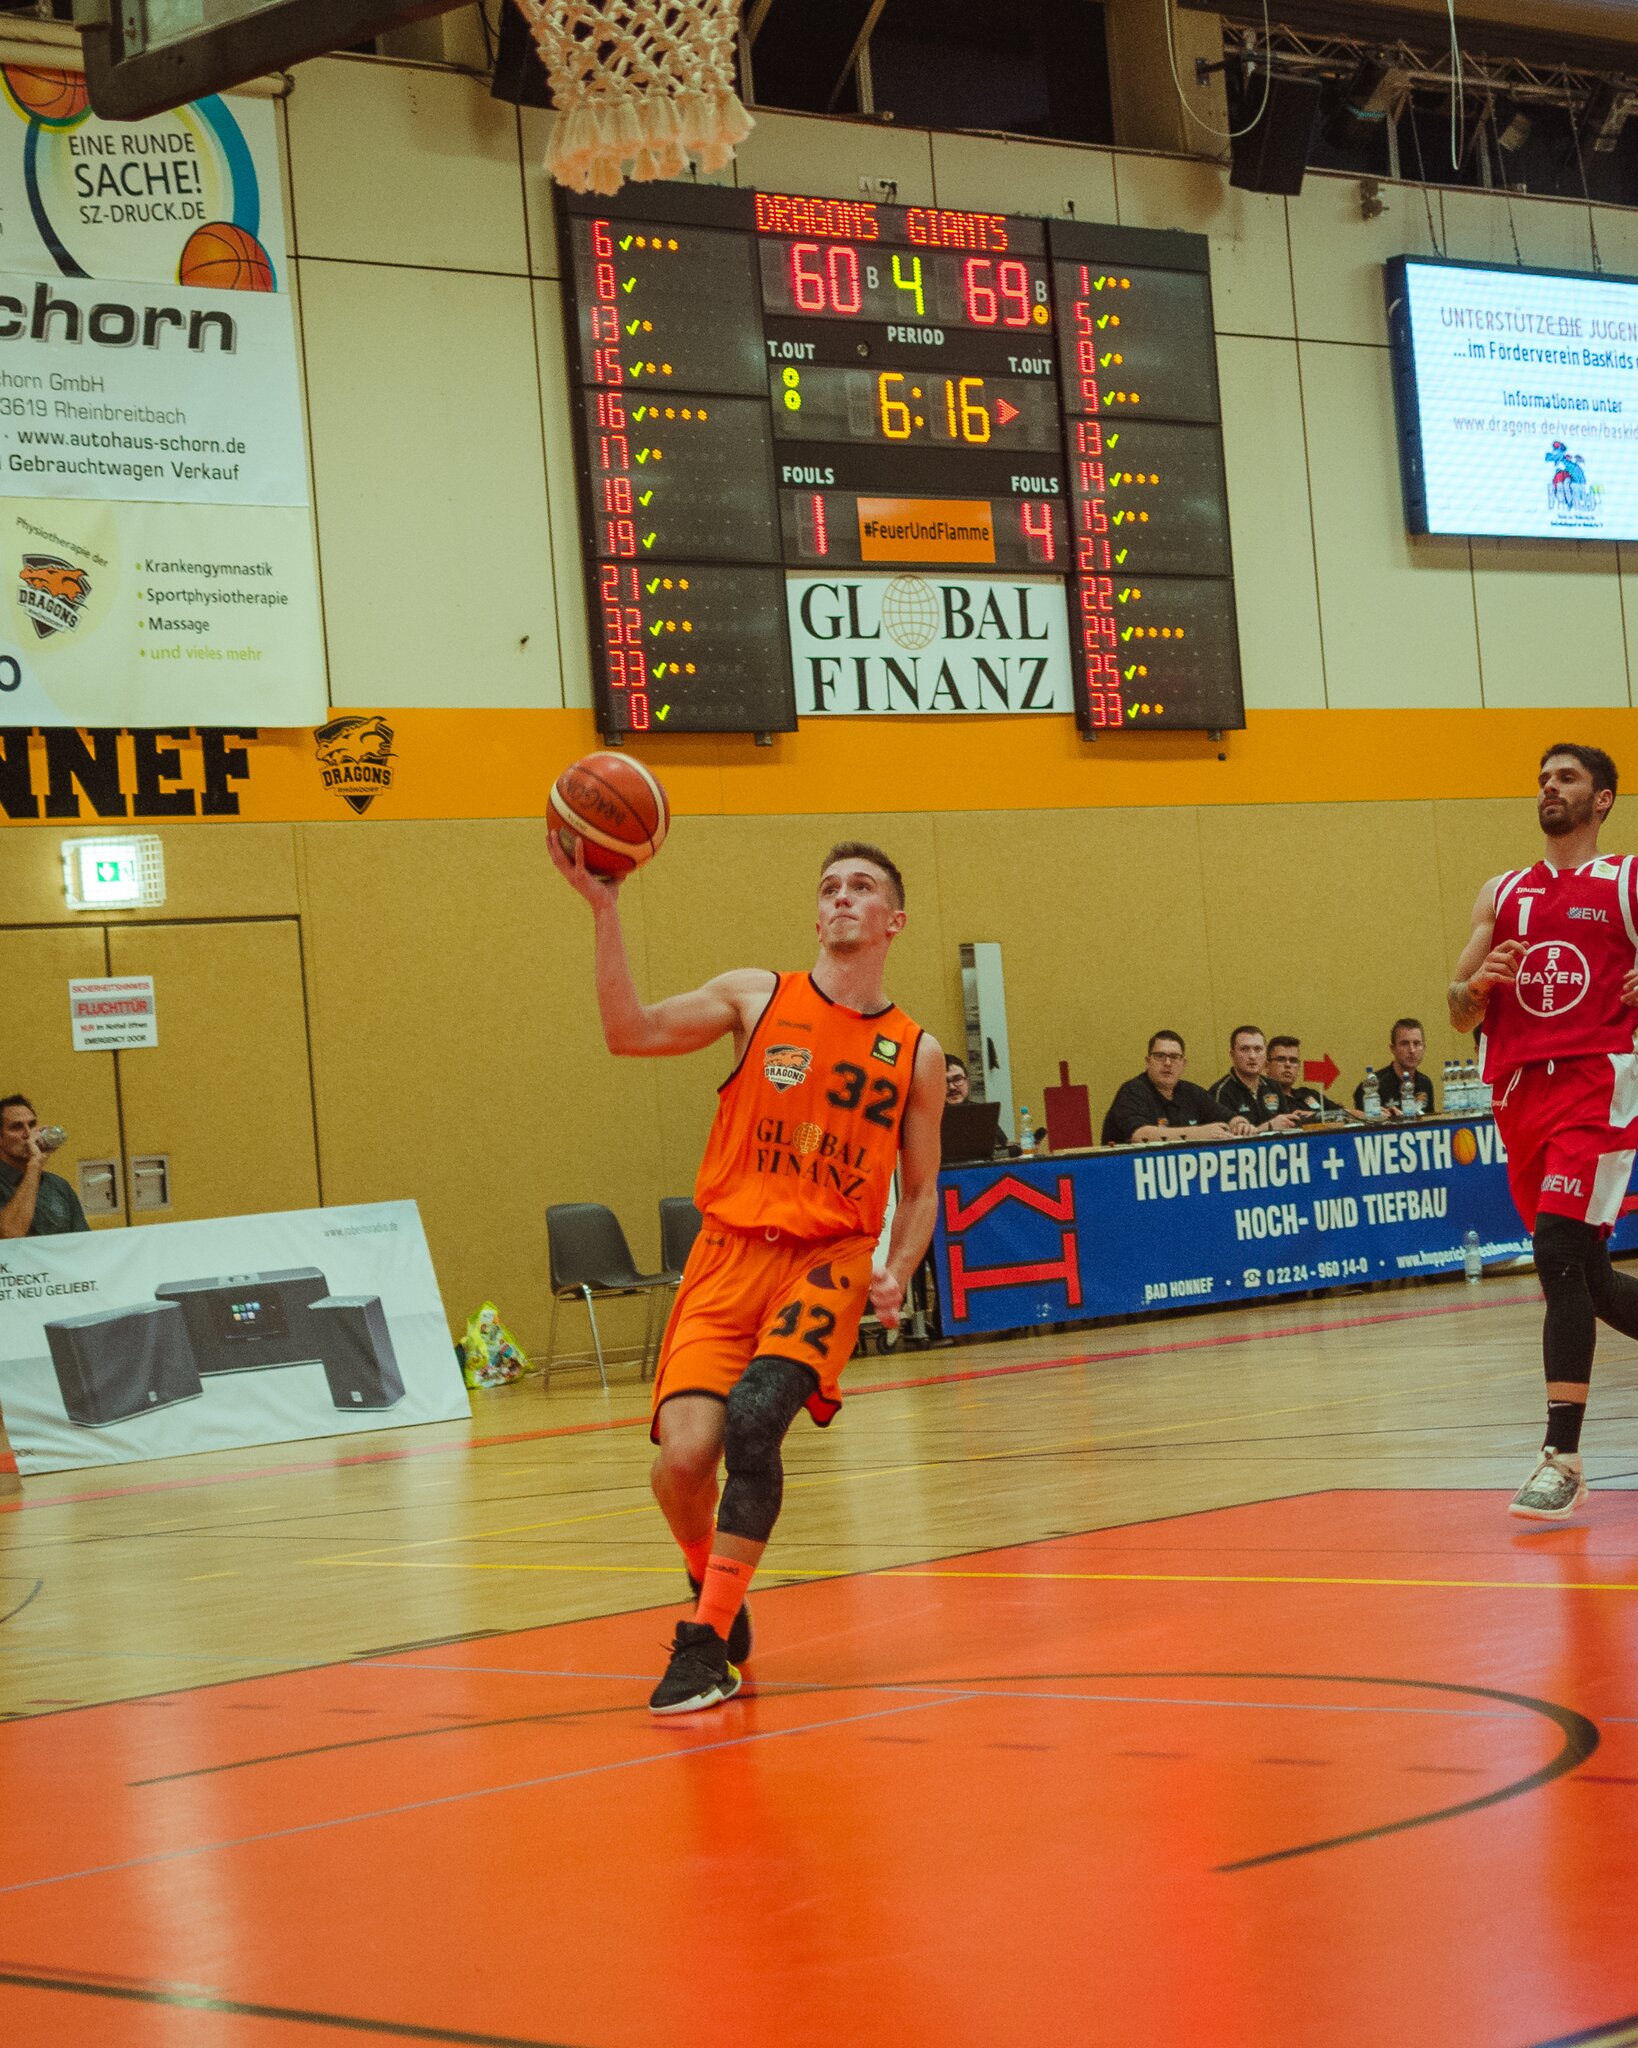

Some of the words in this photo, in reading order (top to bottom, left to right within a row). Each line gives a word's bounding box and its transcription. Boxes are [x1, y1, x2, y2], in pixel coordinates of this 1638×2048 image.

[69, 134, 118, 156] EINE
[121, 133, 196, 156] RUNDE
[74, 160, 202, 198] SACHE!
[80, 202, 207, 225] SZ-DRUCK.DE
[755, 193, 880, 240] DRAGONS
[907, 207, 1009, 252] GIANTS
[593, 219, 613, 258] 6
[597, 262, 617, 300] 8
[791, 241, 863, 315] 60
[866, 265, 880, 289] B
[891, 254, 926, 316] 4
[965, 257, 1031, 327] 69
[1035, 279, 1048, 303] B
[1080, 266, 1091, 295] 1
[591, 306, 620, 342] 13
[887, 326, 945, 346] PERIOD
[1075, 302, 1093, 336] 5
[1440, 305, 1556, 337] UNTERSTÜTZE
[593, 348, 623, 386] 15
[767, 340, 815, 361] T.OUT
[1008, 356, 1052, 376] T.OUT
[1078, 340, 1096, 374] 8
[1489, 341, 1580, 367] Förderverein
[1583, 348, 1634, 371] BasKids
[0, 371, 43, 390] horn
[49, 372, 105, 394] GmbH
[1081, 378, 1099, 414] 9
[0, 397, 49, 418] 3619
[54, 400, 187, 426] Rheinbreitbach
[598, 392, 627, 430] 16
[877, 371, 991, 444] 6:16
[1503, 390, 1590, 411] Informationen
[1592, 398, 1624, 414] unter
[17, 428, 247, 455] www.autohaus-schorn.de
[601, 434, 629, 470] 17
[1077, 420, 1103, 456] 13
[8, 453, 164, 482] Gebrauchtwagen
[171, 461, 240, 482] Verkauf
[782, 465, 835, 485] FOULS
[1011, 475, 1059, 494] FOULS
[1080, 461, 1106, 493] 14
[605, 477, 633, 514] 18
[811, 494, 828, 557] 1
[863, 521, 990, 542] #FeuerUndFlamme
[1021, 502, 1055, 561] 4
[1083, 498, 1109, 533] 15
[16, 516, 91, 559] Physiotherapie
[92, 554, 109, 568] der
[608, 520, 637, 558] 19
[1079, 537, 1113, 571] 21
[145, 558, 275, 579] Krankengymnastik
[601, 564, 640, 602] 21
[18, 588, 79, 629] DRAGONS
[146, 587, 290, 609] Sportphysiotherapie
[1081, 576, 1114, 611] 22
[148, 617, 211, 634] Massage
[605, 607, 643, 645] 32
[800, 578, 1049, 645] GLOBAL
[1084, 615, 1118, 649] 24
[150, 646, 182, 661] und
[186, 647, 223, 661] vieles
[226, 646, 264, 662] mehr
[608, 649, 647, 688] 33
[1087, 653, 1121, 688] 25
[804, 655, 1056, 713] FINANZ
[631, 692, 650, 730] 0
[1091, 691, 1125, 728] 33
[321, 765, 392, 787] DRAGONS
[1517, 896, 1535, 936] 1
[1580, 907, 1610, 924] EVL
[1519, 971, 1584, 986] BAYER
[1541, 947, 1562, 1011] BAYER
[765, 1066, 805, 1083] DRAGONS
[825, 1060, 900, 1132] 32
[756, 1118, 872, 1174] GLOBAL
[756, 1148, 867, 1202] FINANZ
[1133, 1141, 1311, 1202] HUPPERICH
[1233, 1201, 1309, 1241] HOCH-
[1314, 1198, 1358, 1233] UND
[1362, 1186, 1448, 1227] TIEFBAU
[17, 1286, 43, 1299] NEU
[45, 1280, 99, 1297] GELIEBT.
[1144, 1283, 1169, 1300] BAD
[1170, 1276, 1214, 1298] HONNEF
